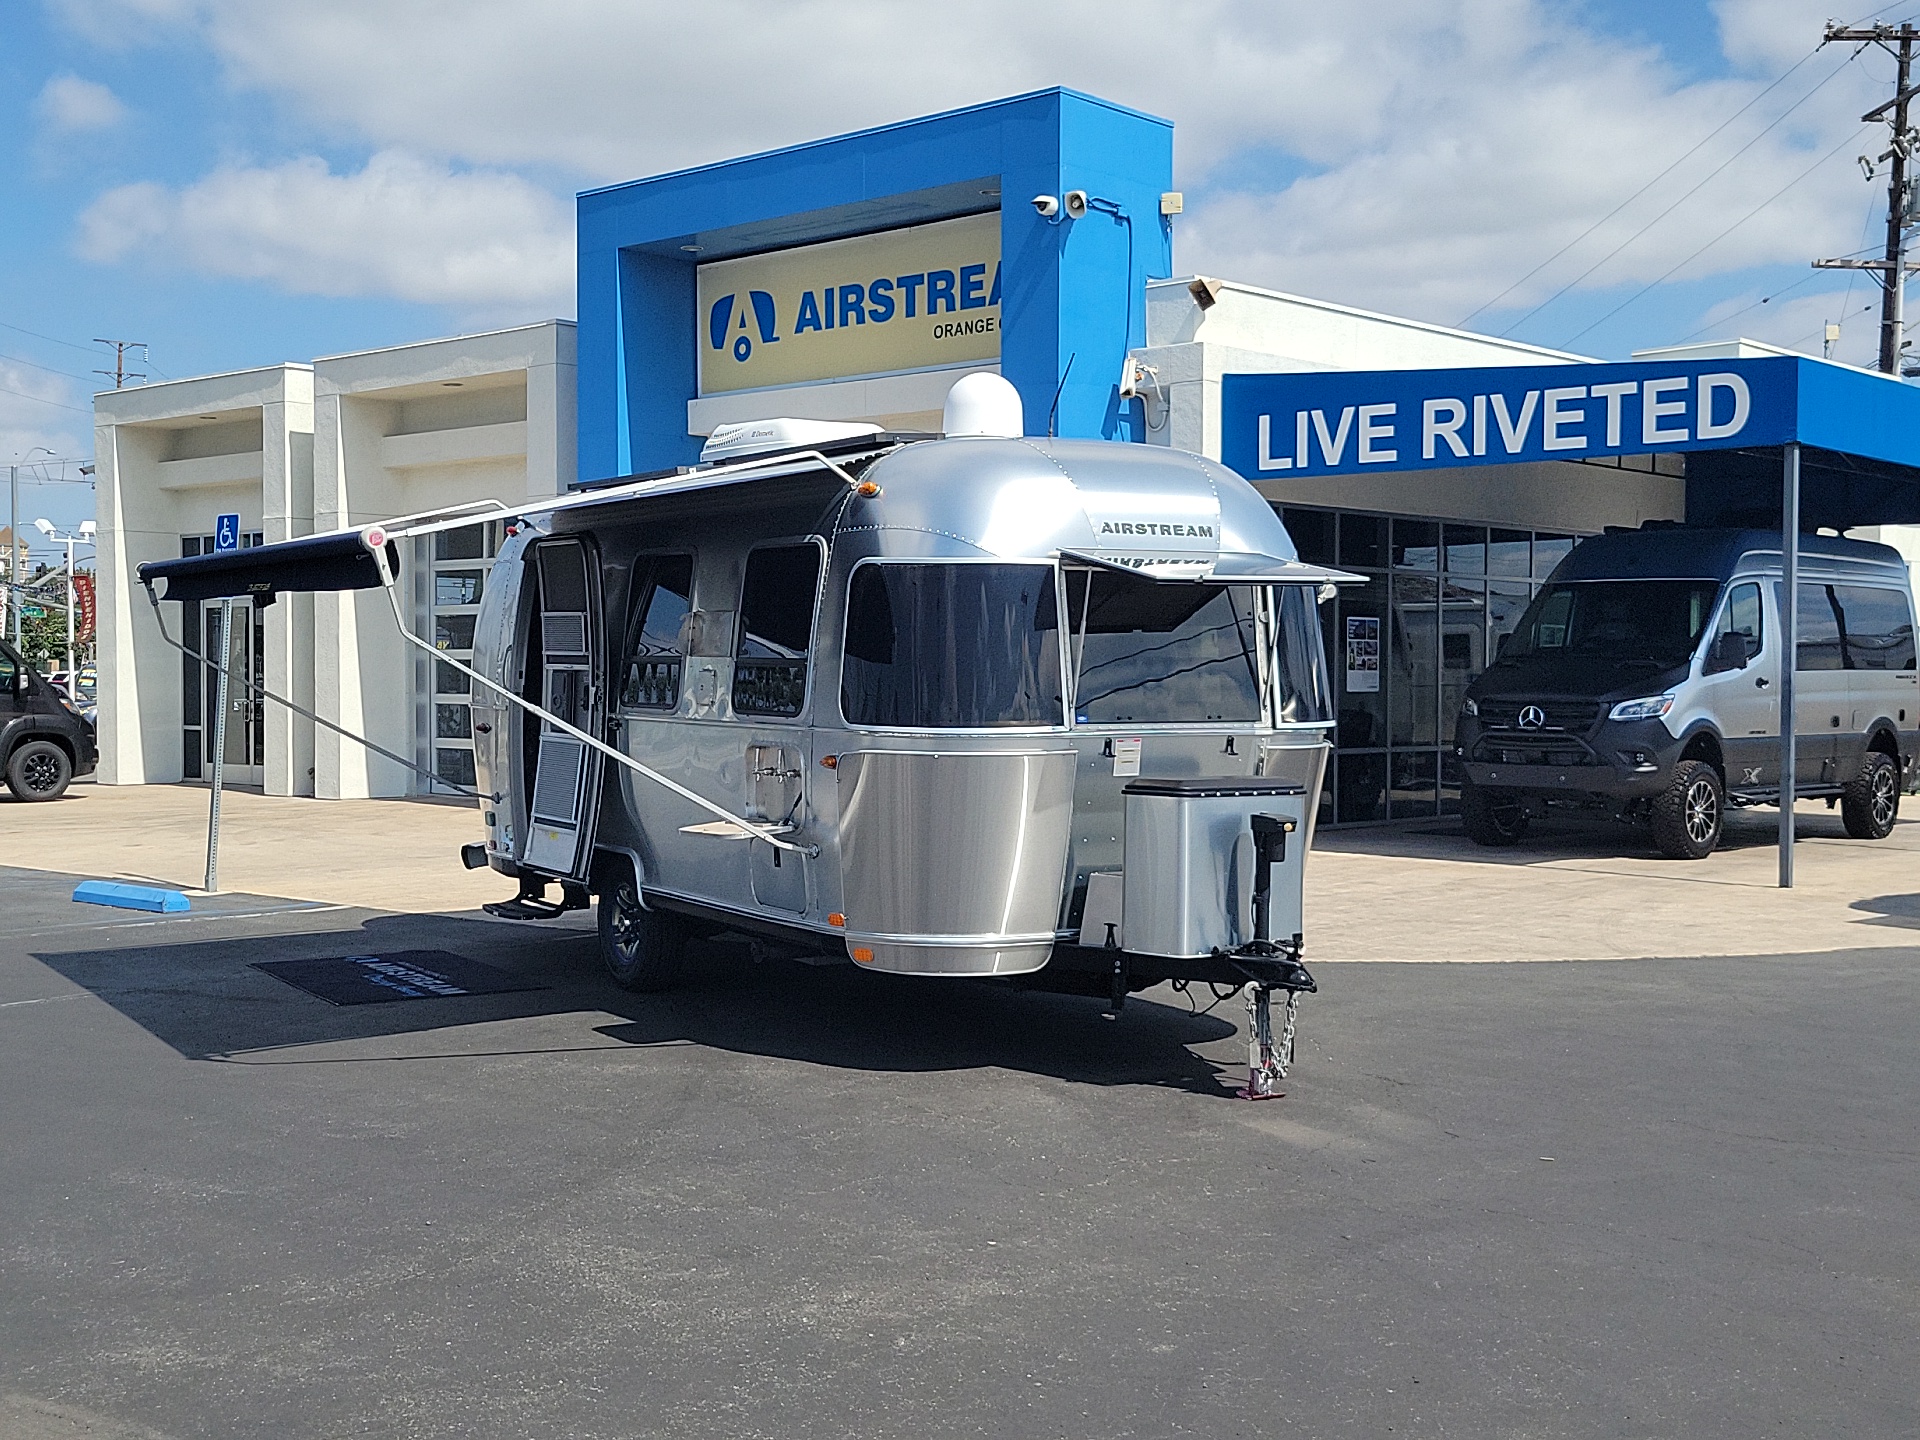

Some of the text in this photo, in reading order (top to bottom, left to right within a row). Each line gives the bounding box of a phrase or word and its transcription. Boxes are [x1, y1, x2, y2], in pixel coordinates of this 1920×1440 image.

[934, 317, 995, 339] ORANGE
[1258, 372, 1751, 471] LIVE RIVETED
[1101, 521, 1213, 538] AIRSTREAM
